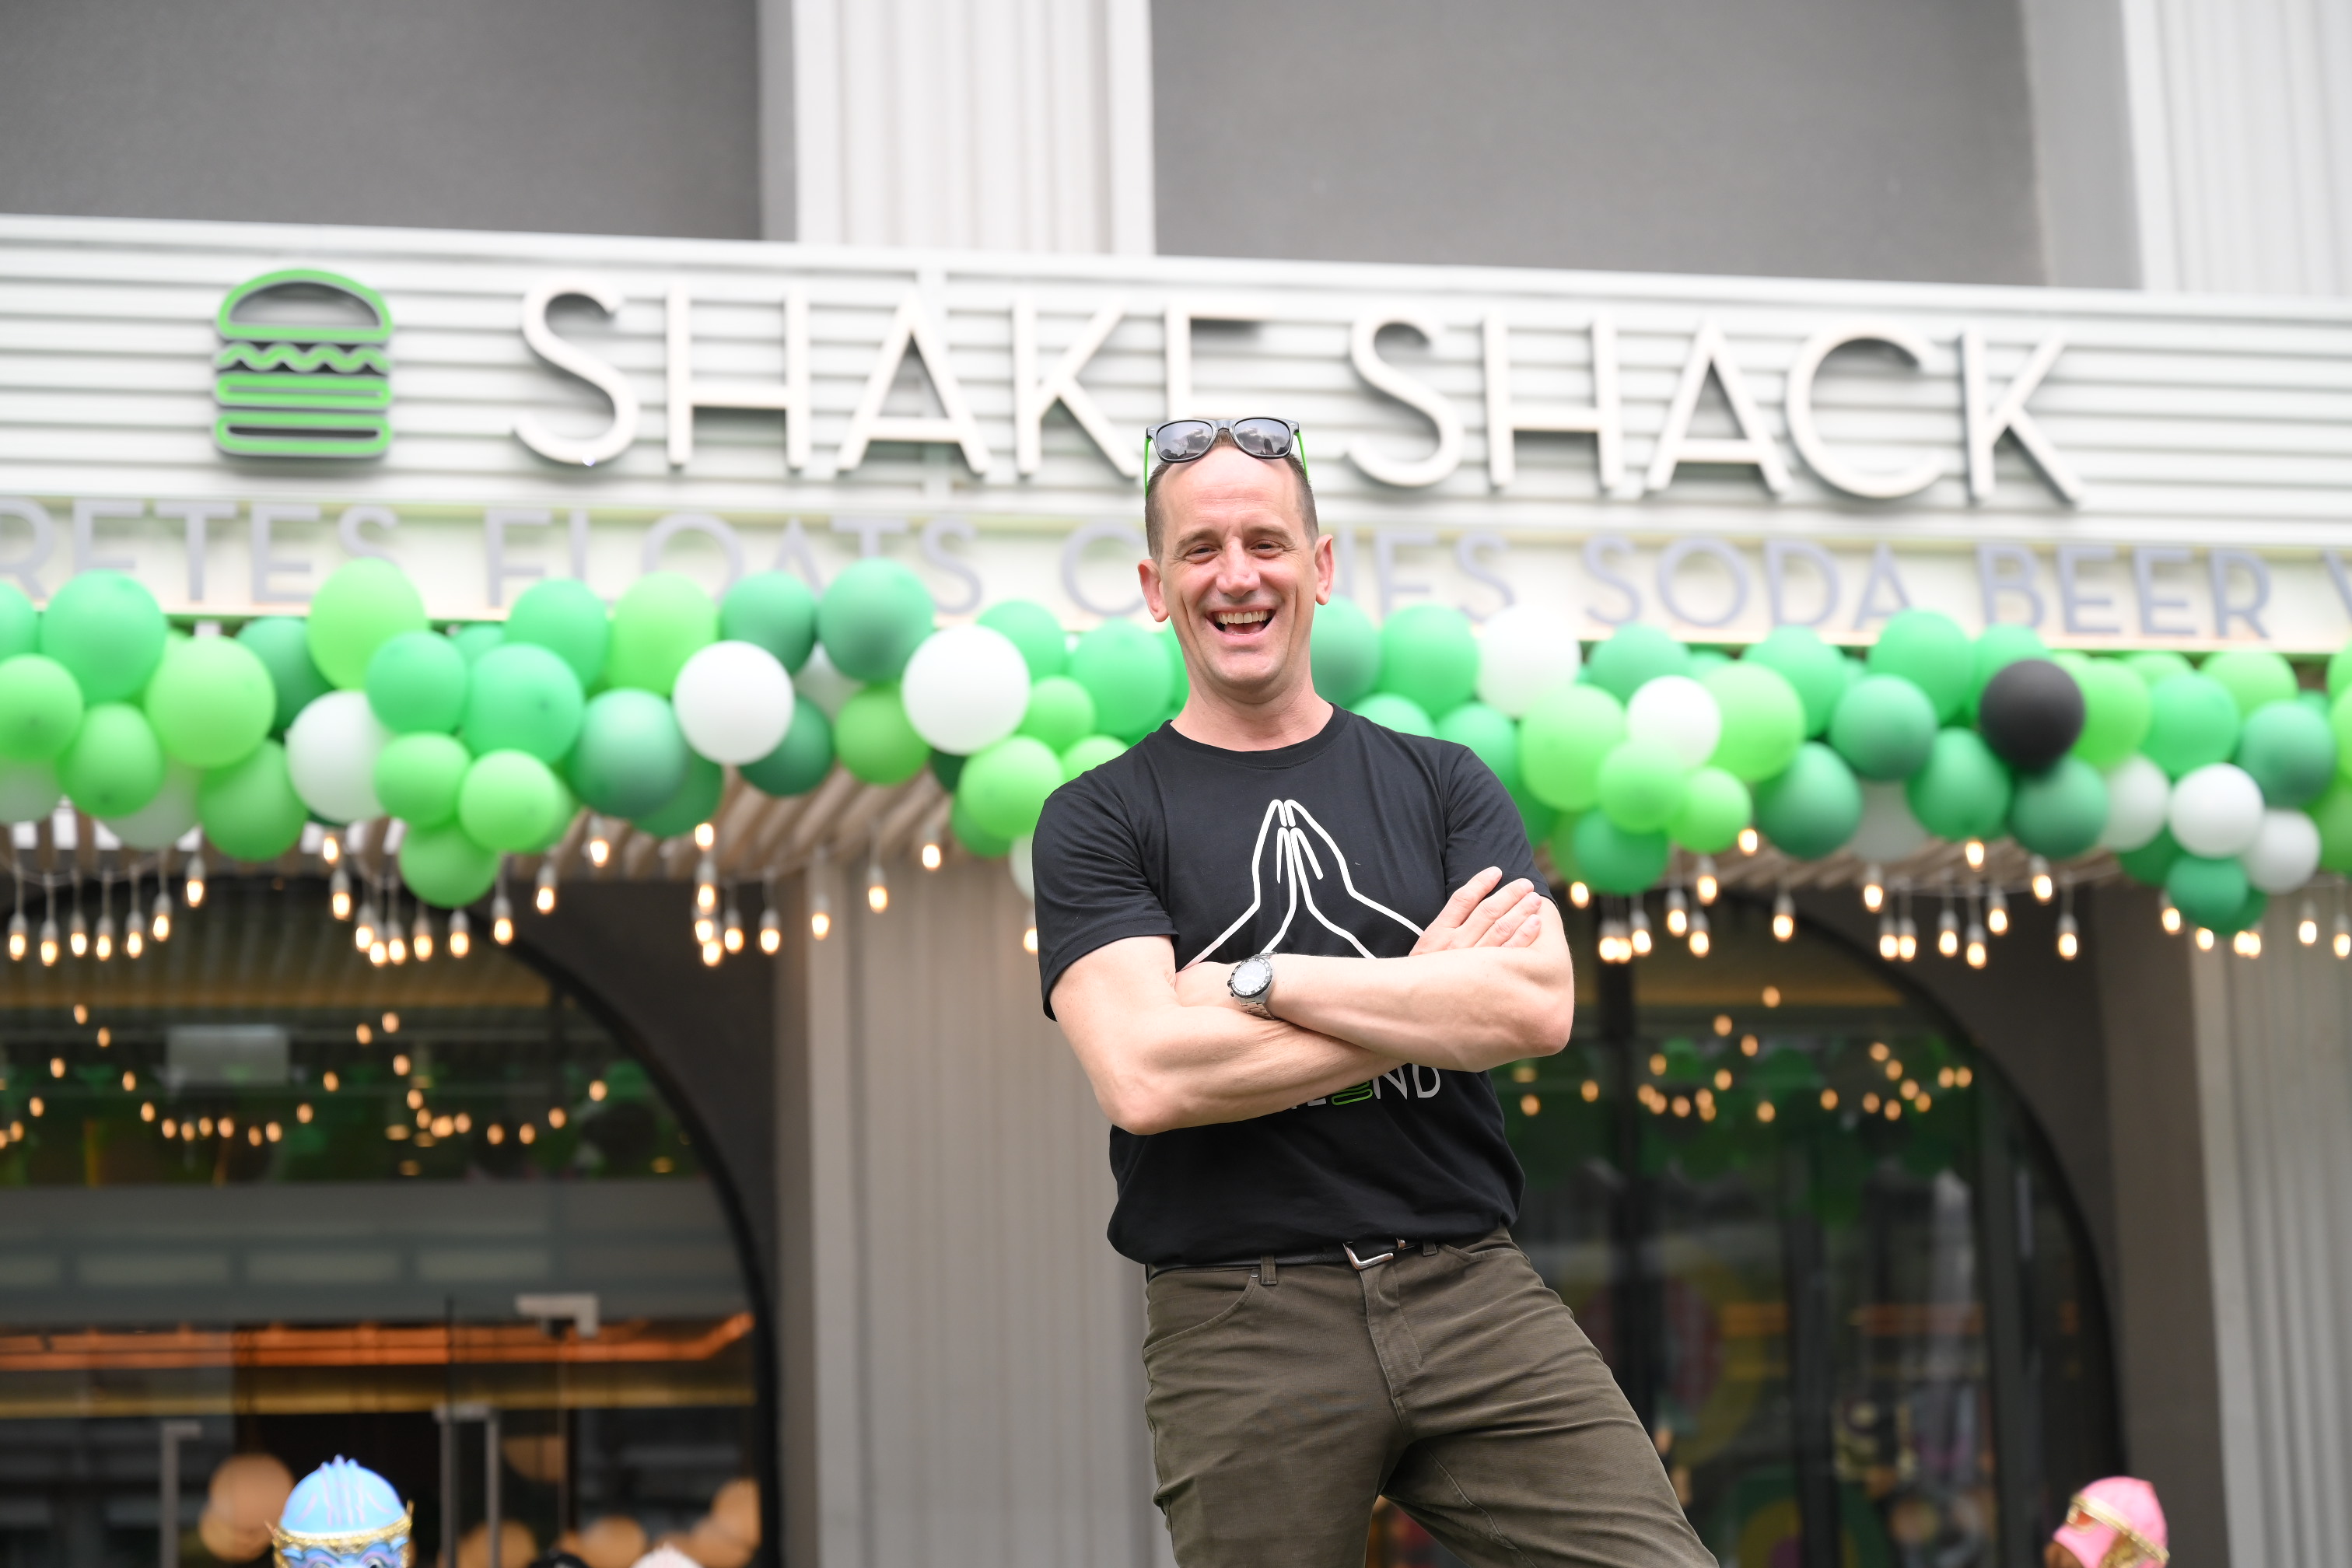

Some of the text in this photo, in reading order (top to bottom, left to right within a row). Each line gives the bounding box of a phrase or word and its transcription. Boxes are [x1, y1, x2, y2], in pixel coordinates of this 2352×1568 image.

[509, 274, 2084, 503] SHAKE SHACK
[1580, 534, 1913, 631] SODA
[1978, 544, 2270, 639] BEER
